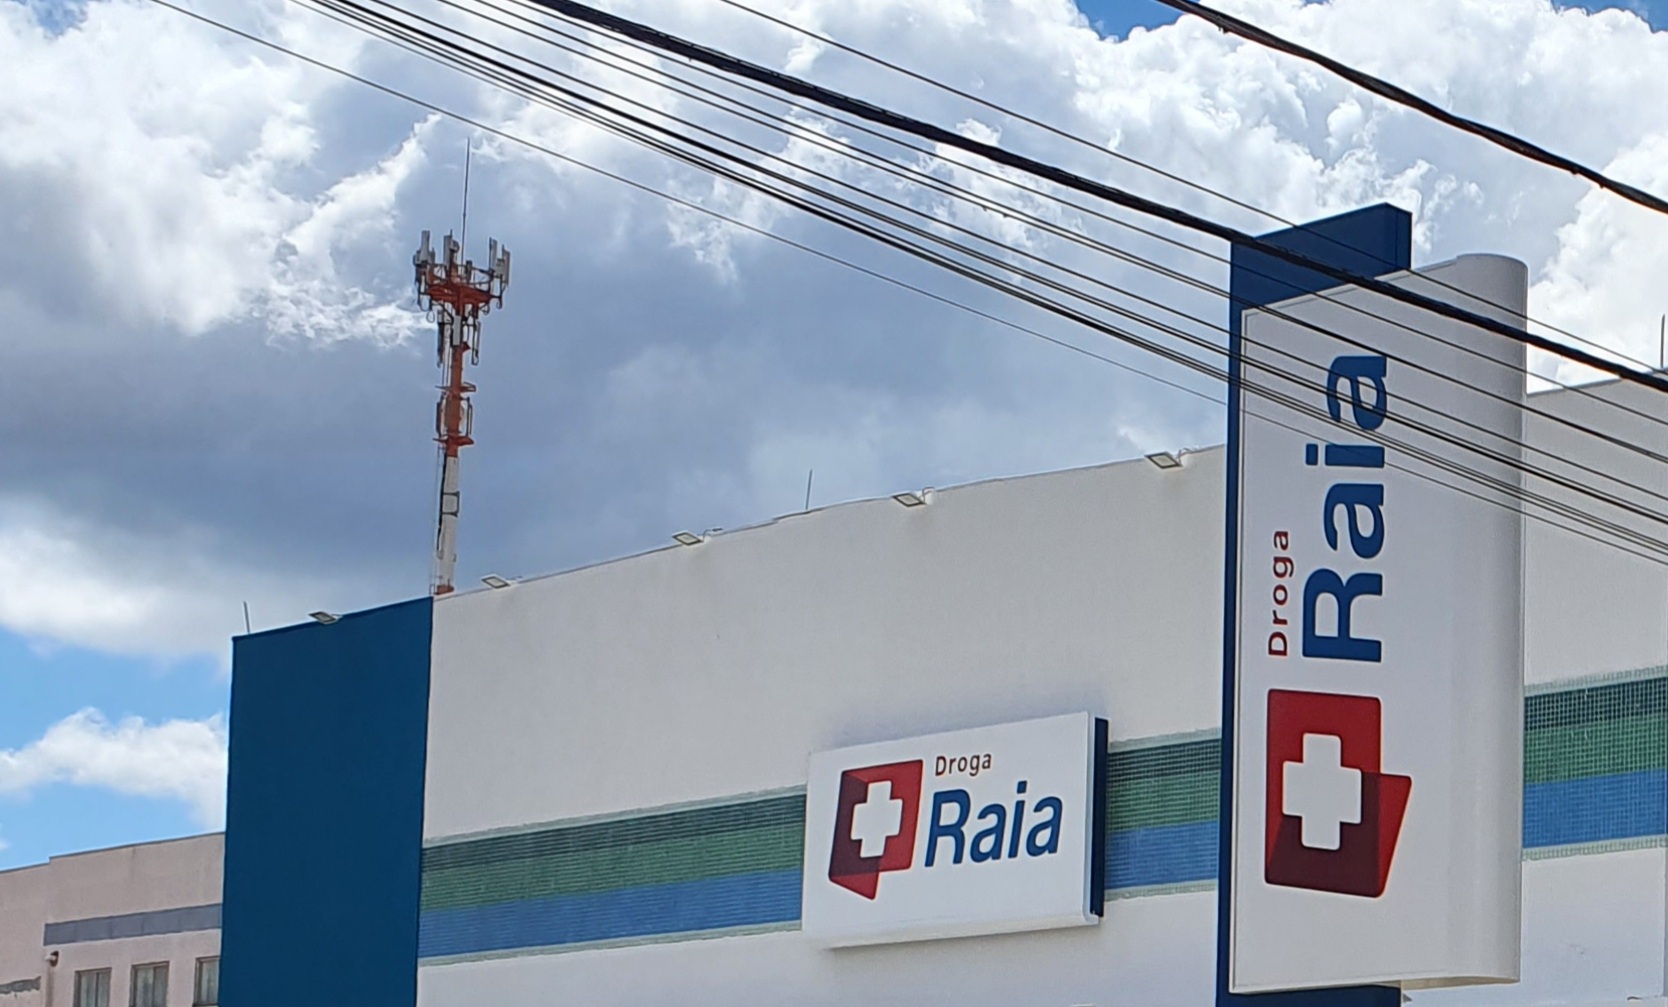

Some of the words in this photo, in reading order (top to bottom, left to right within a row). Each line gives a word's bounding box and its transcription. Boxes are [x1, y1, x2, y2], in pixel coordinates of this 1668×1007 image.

[1301, 354, 1388, 663] Raia
[1267, 529, 1295, 658] Droga
[934, 752, 993, 777] Droga
[923, 780, 1064, 868] Raia
